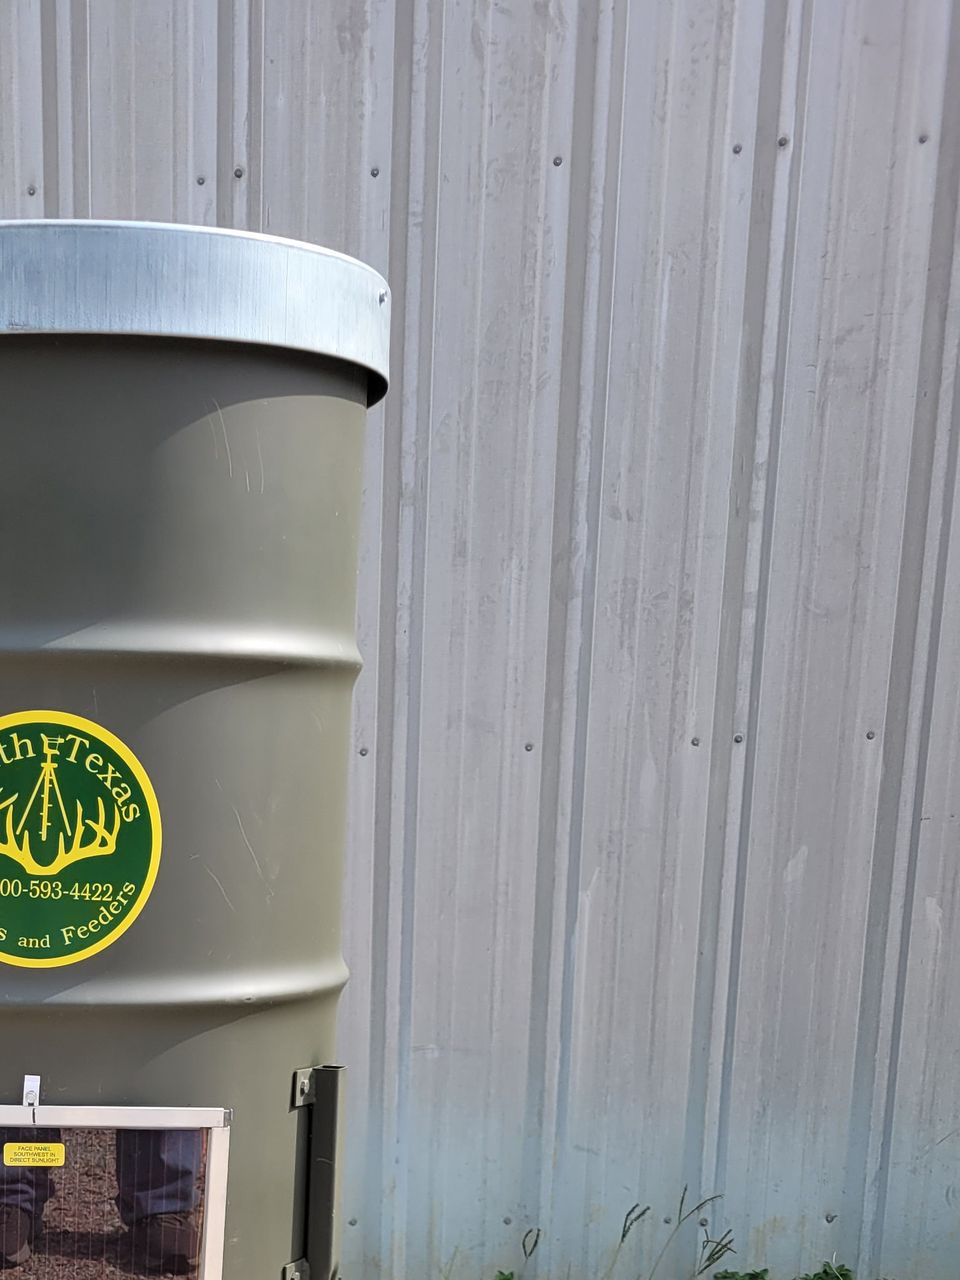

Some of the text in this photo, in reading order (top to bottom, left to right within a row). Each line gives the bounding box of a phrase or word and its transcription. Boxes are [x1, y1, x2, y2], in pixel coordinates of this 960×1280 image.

[64, 734, 141, 823] Texas
[18, 935, 50, 949] and
[60, 881, 136, 946] Feeders
